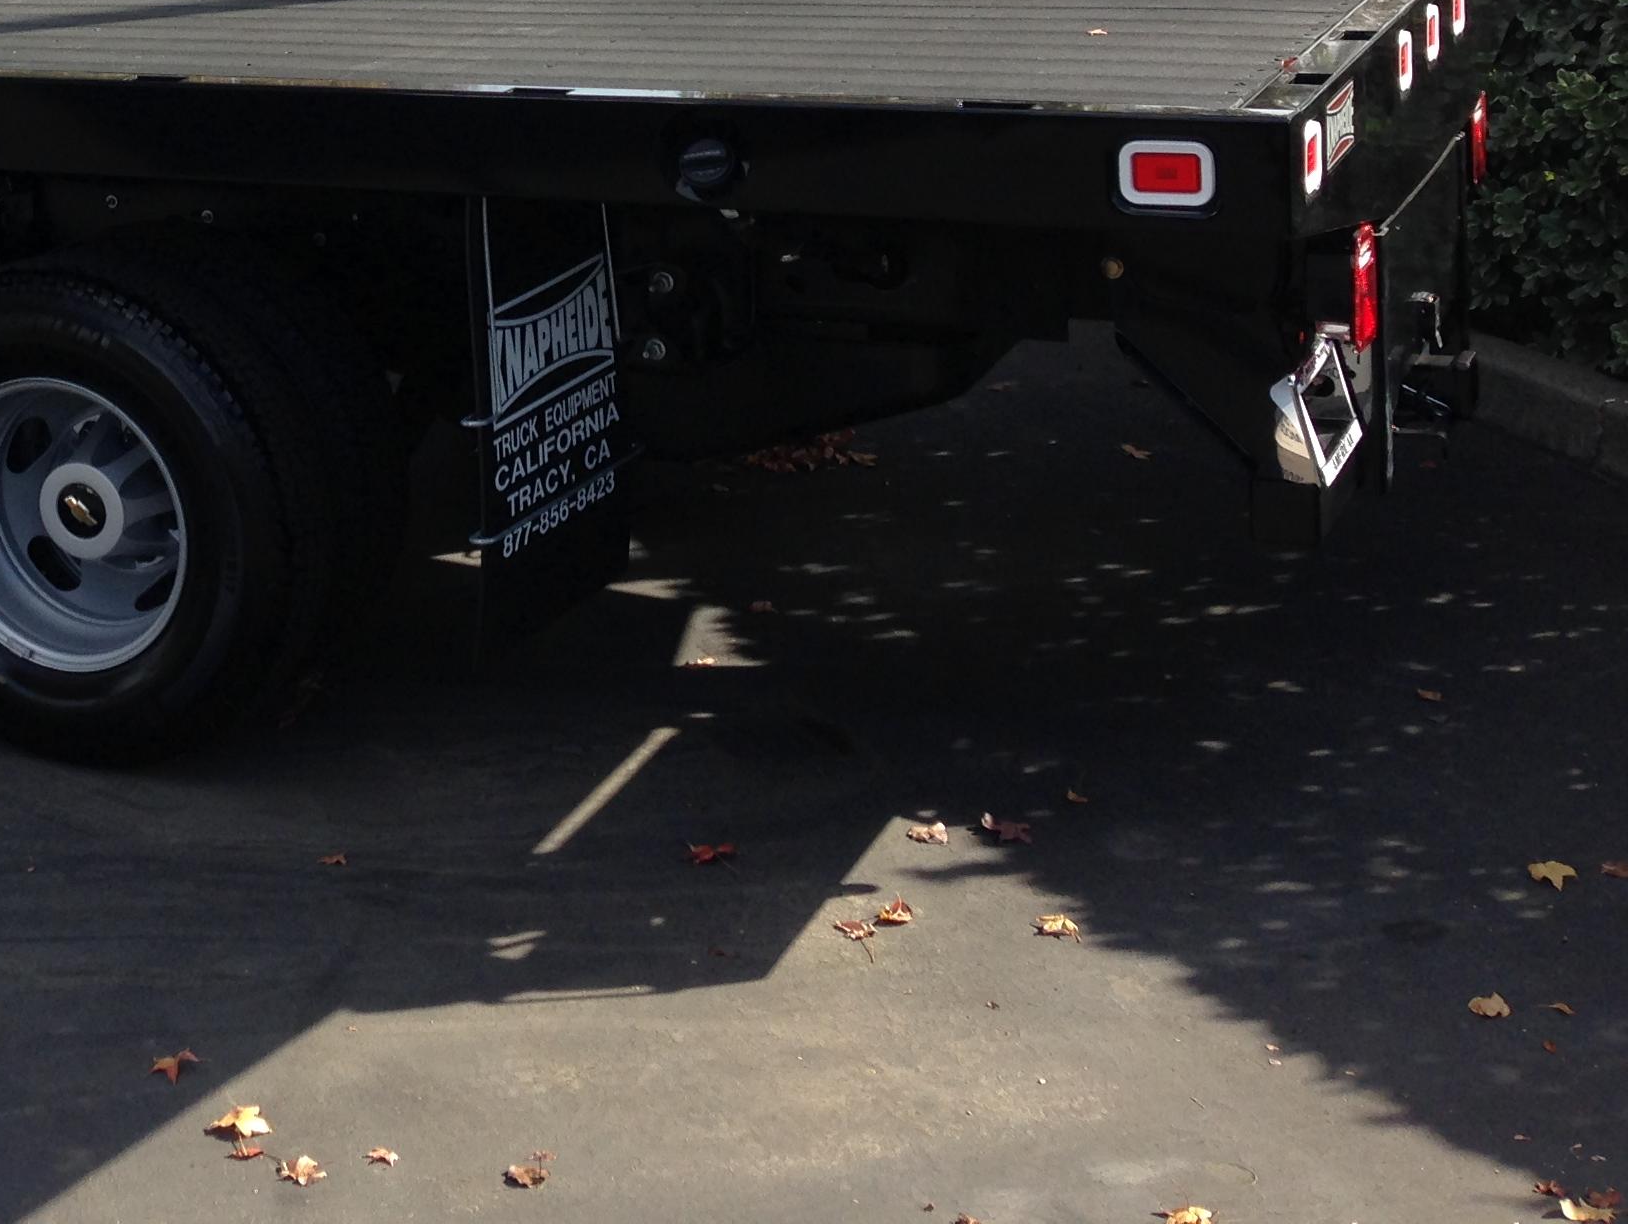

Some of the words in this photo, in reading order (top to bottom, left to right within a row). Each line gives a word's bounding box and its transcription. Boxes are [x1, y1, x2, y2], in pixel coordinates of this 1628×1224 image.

[489, 267, 613, 413] KNAPHEIDE
[493, 415, 539, 462] TRUCK
[544, 371, 617, 432] EQUIPMENT
[494, 401, 620, 492] CALIFORNIA
[503, 471, 615, 558] 877-856-8423
[507, 459, 576, 517] TRACY,
[584, 438, 611, 470] CA
